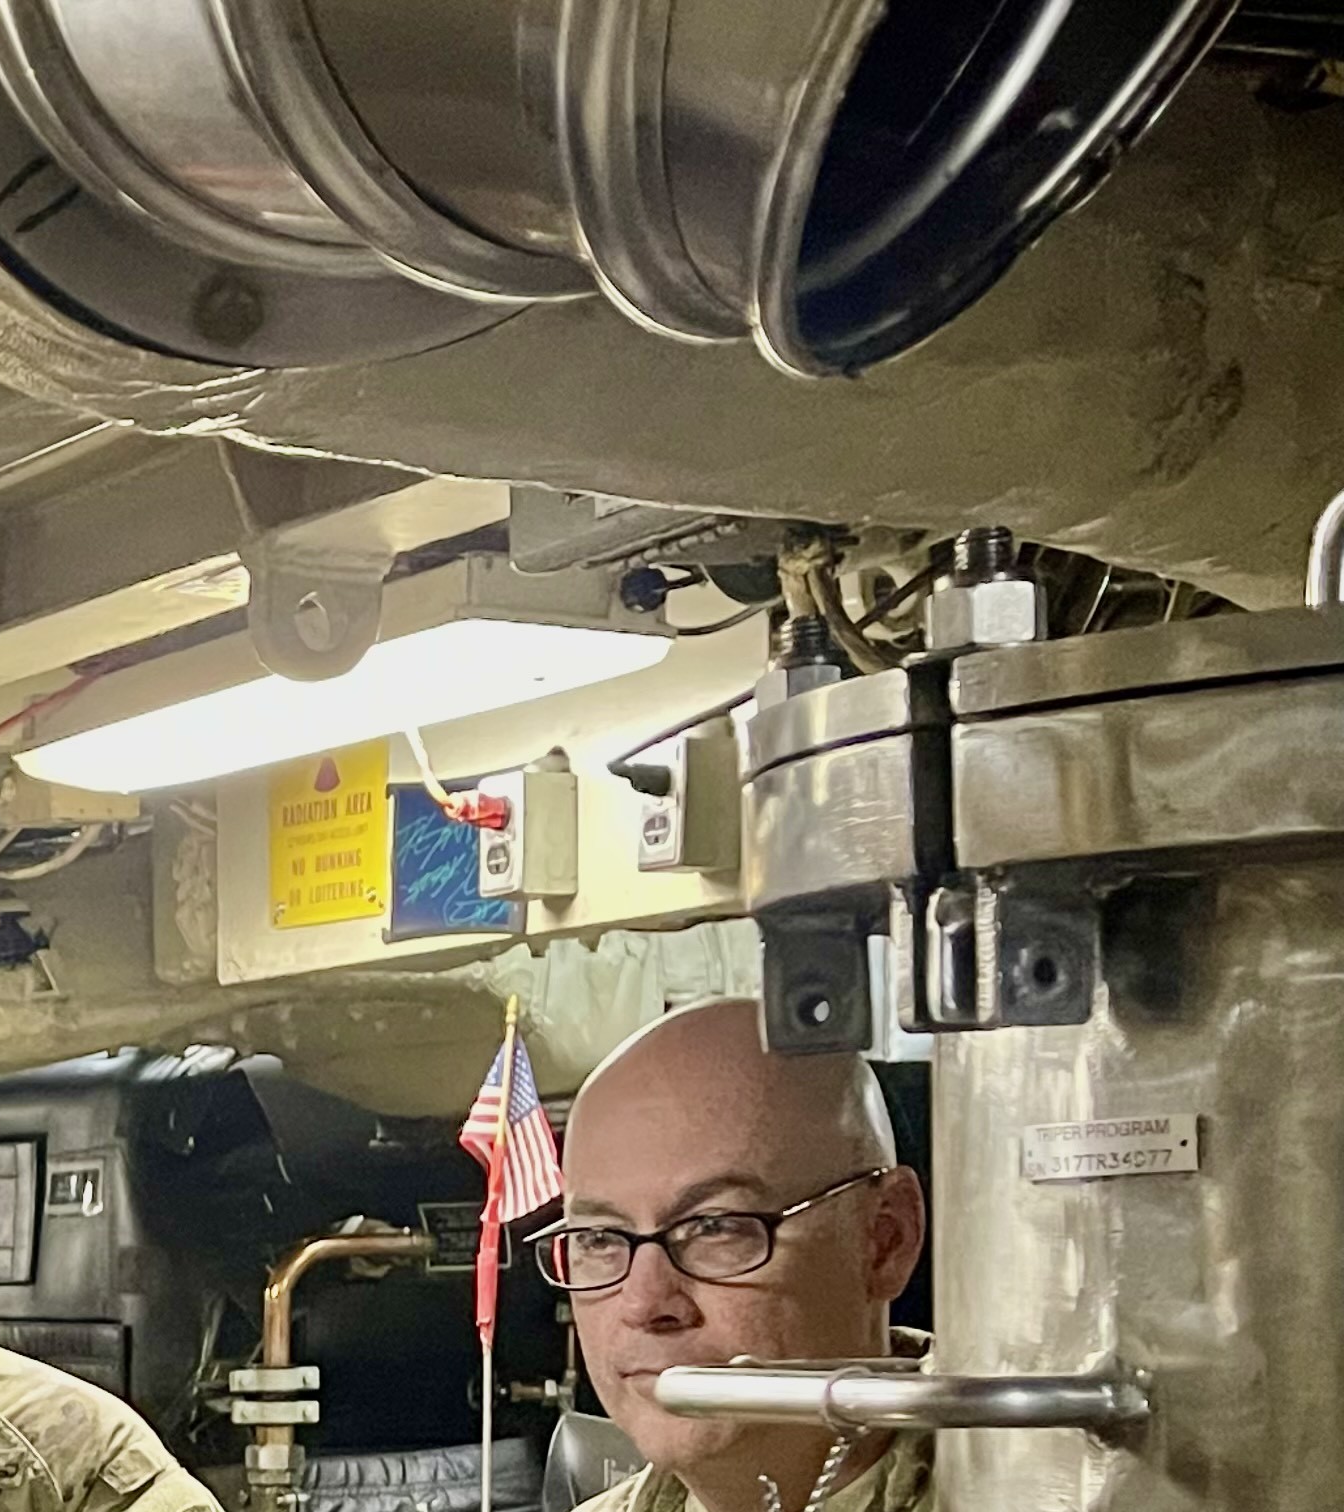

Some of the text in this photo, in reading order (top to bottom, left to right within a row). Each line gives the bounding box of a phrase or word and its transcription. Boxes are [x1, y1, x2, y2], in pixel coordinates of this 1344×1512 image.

[282, 792, 372, 827] RADIATION AREA
[1086, 1118, 1170, 1138] PROGRAM
